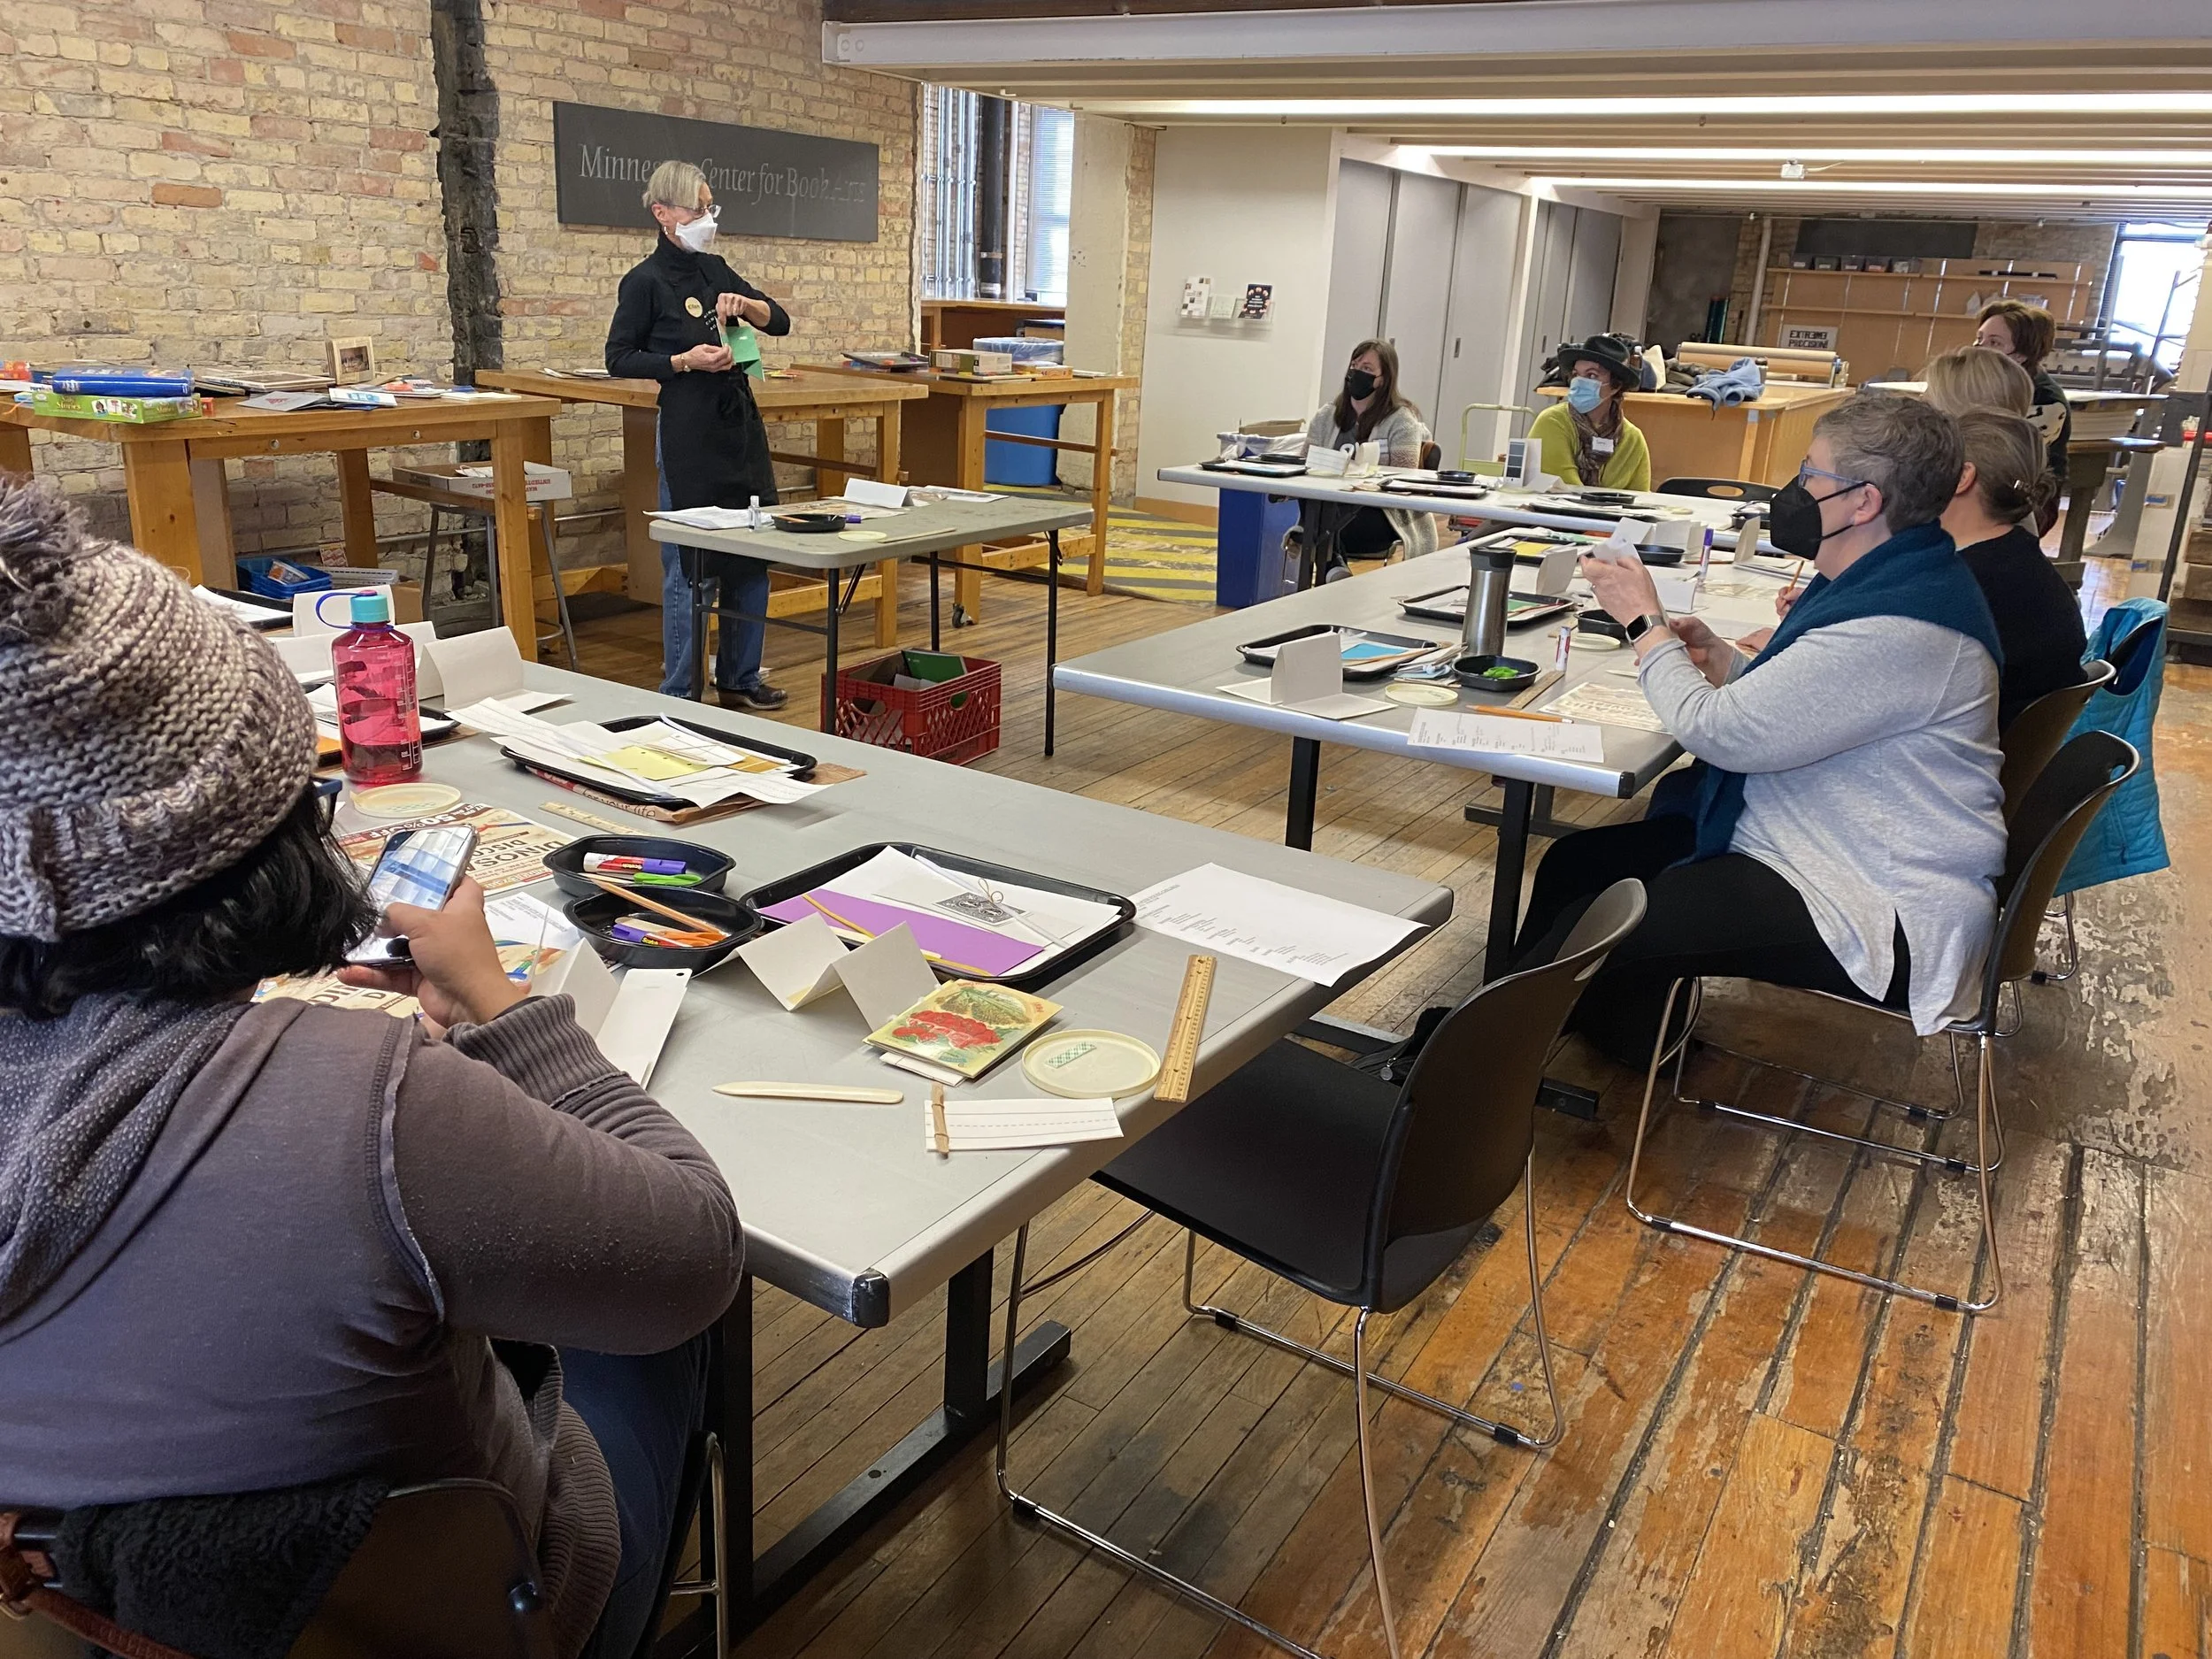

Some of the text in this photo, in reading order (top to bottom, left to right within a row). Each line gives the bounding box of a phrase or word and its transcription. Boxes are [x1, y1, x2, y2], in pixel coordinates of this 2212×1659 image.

[578, 142, 662, 183] Minne
[750, 162, 784, 206] for
[1789, 330, 1828, 340] EXTREME
[403, 813, 457, 830] 50%
[469, 840, 565, 872] DINOS
[472, 839, 527, 856] DISCO
